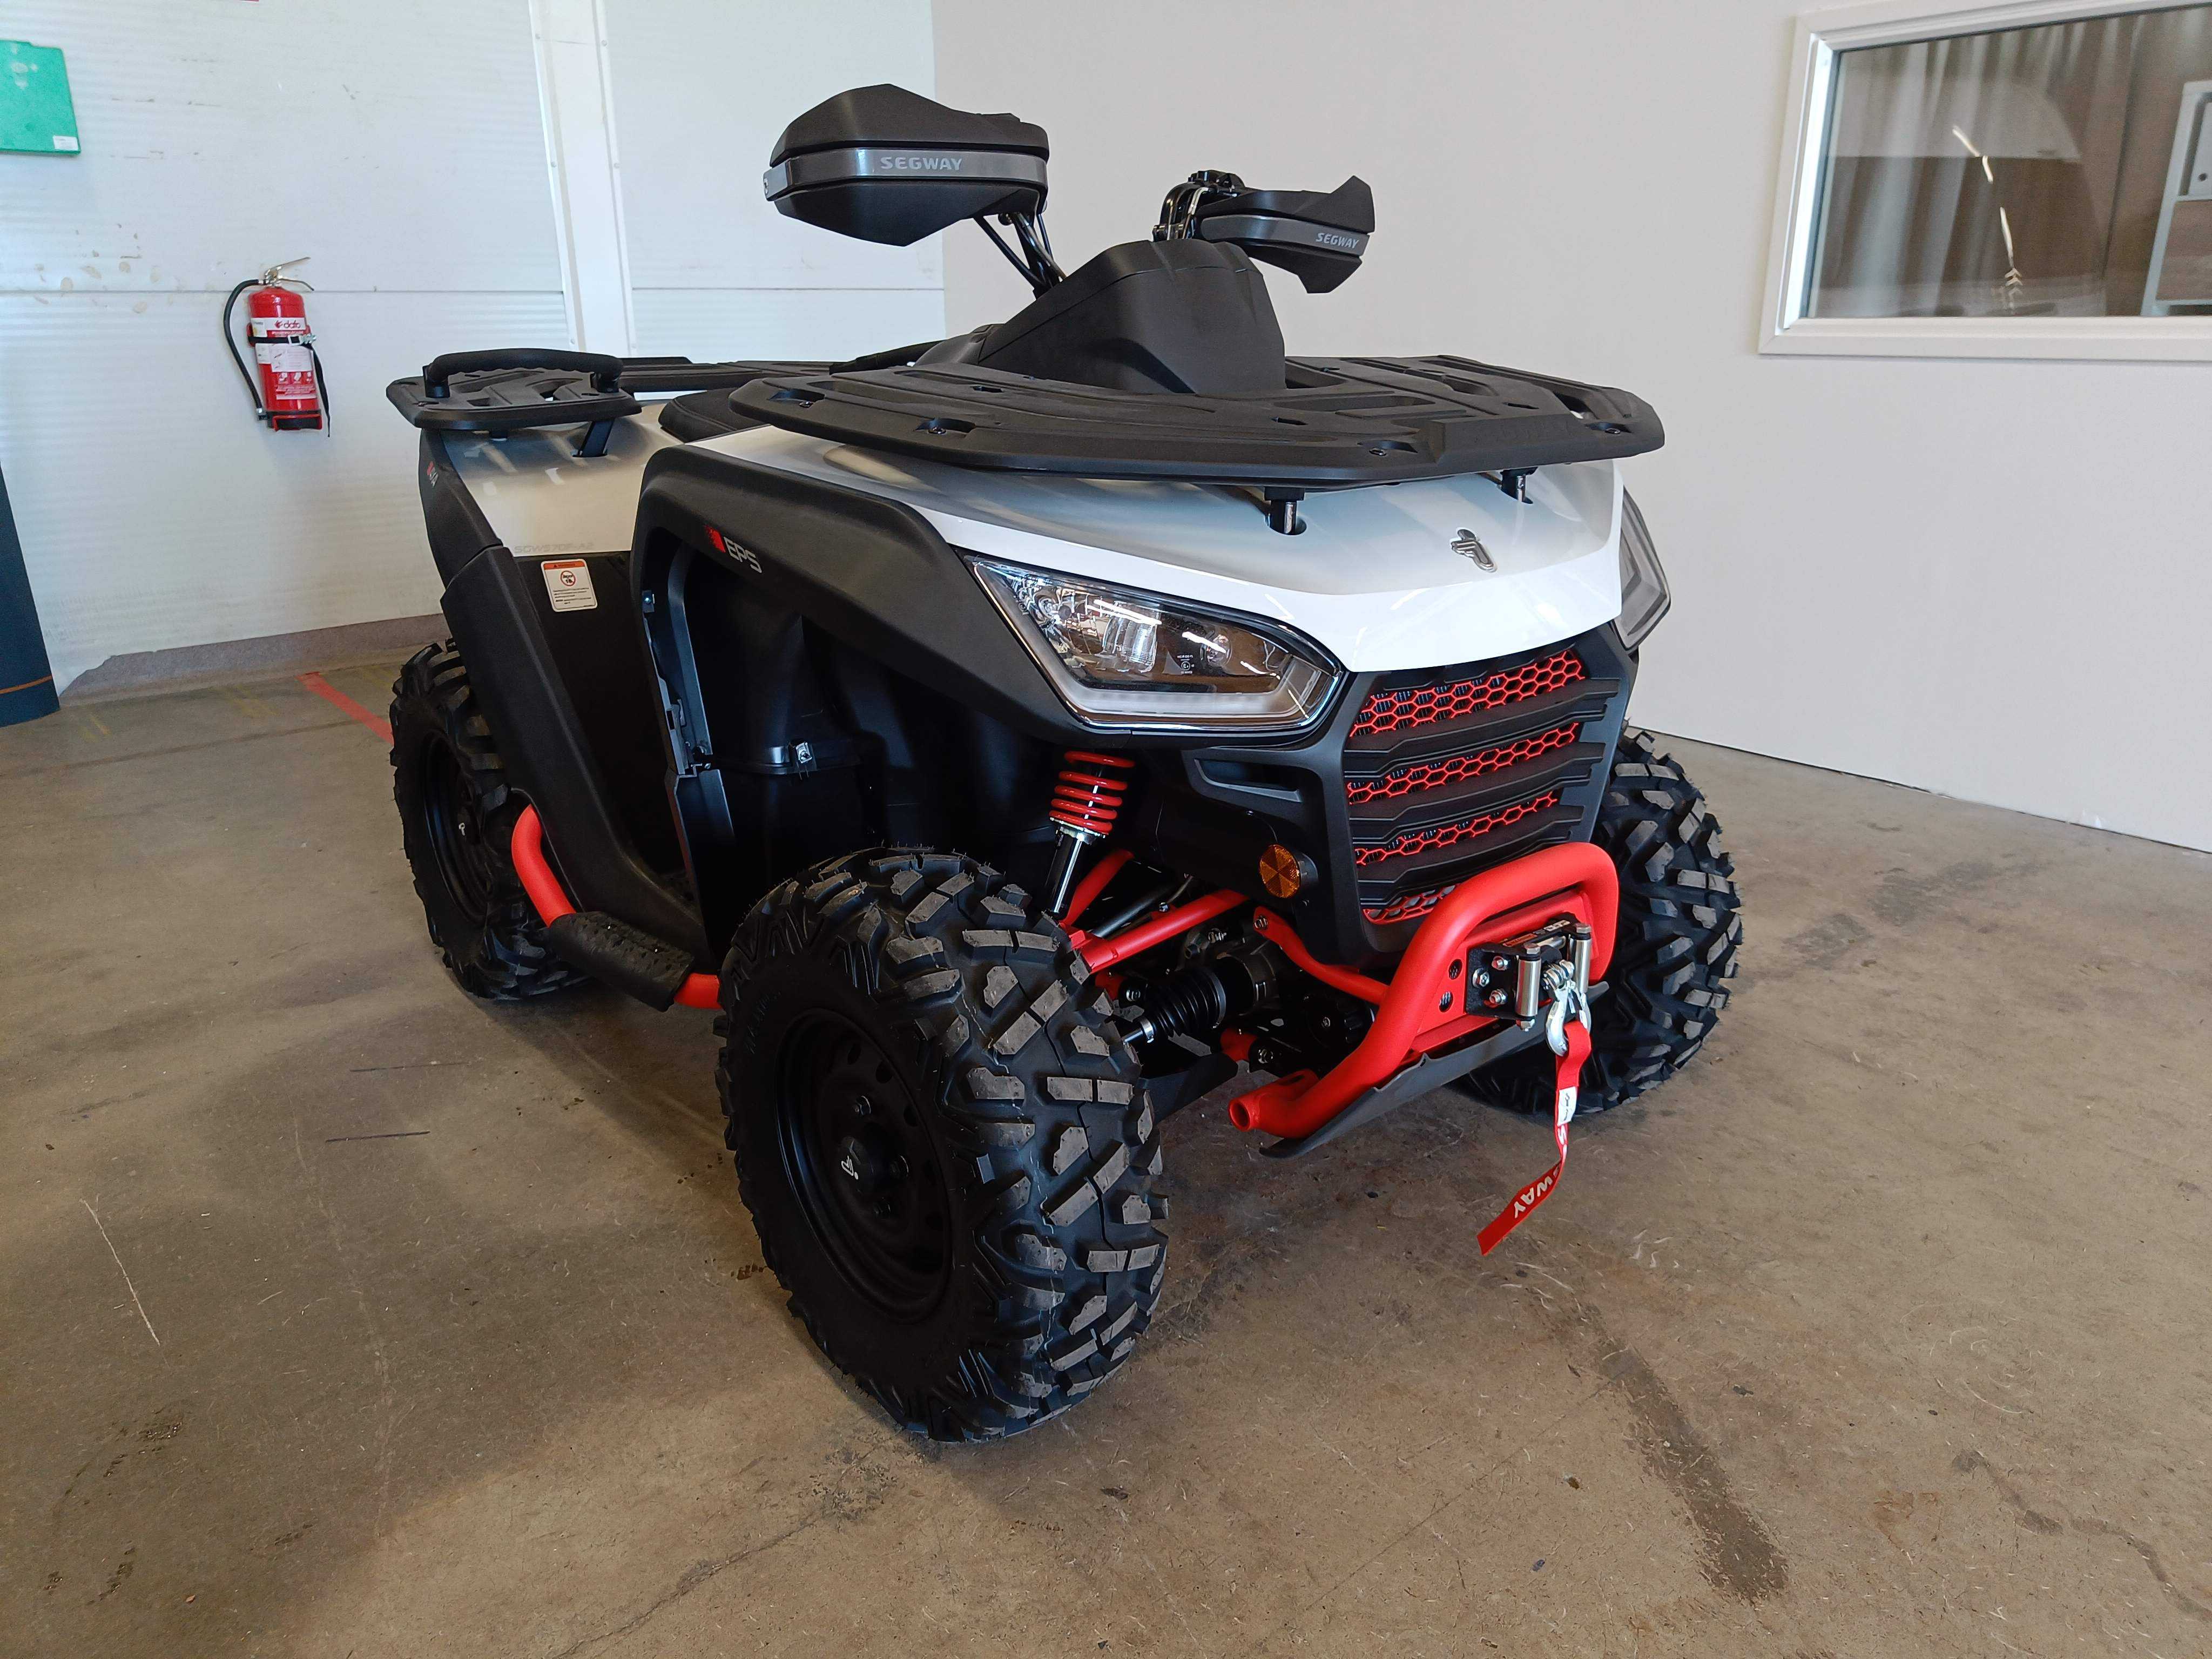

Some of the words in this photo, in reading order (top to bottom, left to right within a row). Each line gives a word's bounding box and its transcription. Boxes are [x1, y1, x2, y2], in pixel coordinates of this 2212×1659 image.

[880, 157, 962, 171] SEGWAY
[1316, 233, 1359, 248] SEGWAY
[724, 536, 762, 574] EPS
